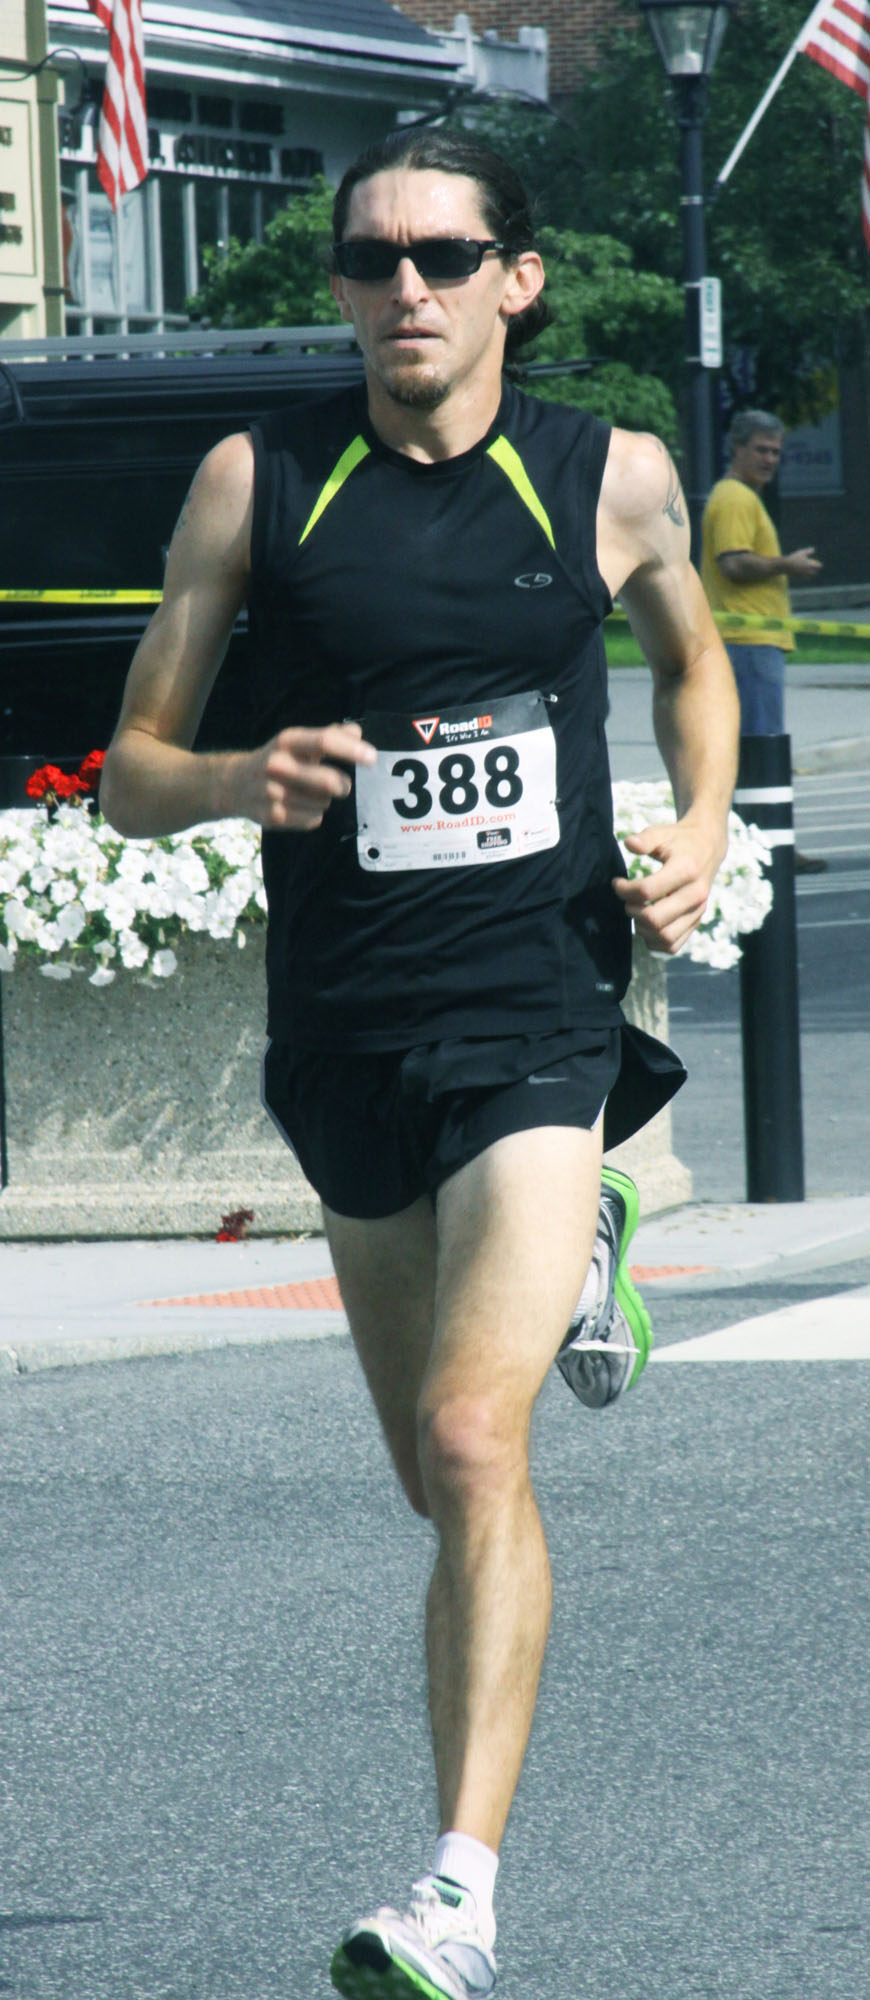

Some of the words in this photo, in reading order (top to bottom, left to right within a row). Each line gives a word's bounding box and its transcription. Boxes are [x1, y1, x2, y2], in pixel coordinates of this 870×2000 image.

[439, 714, 493, 736] RoadID
[391, 745, 524, 820] 388
[400, 812, 516, 833] www.RoadID.com
